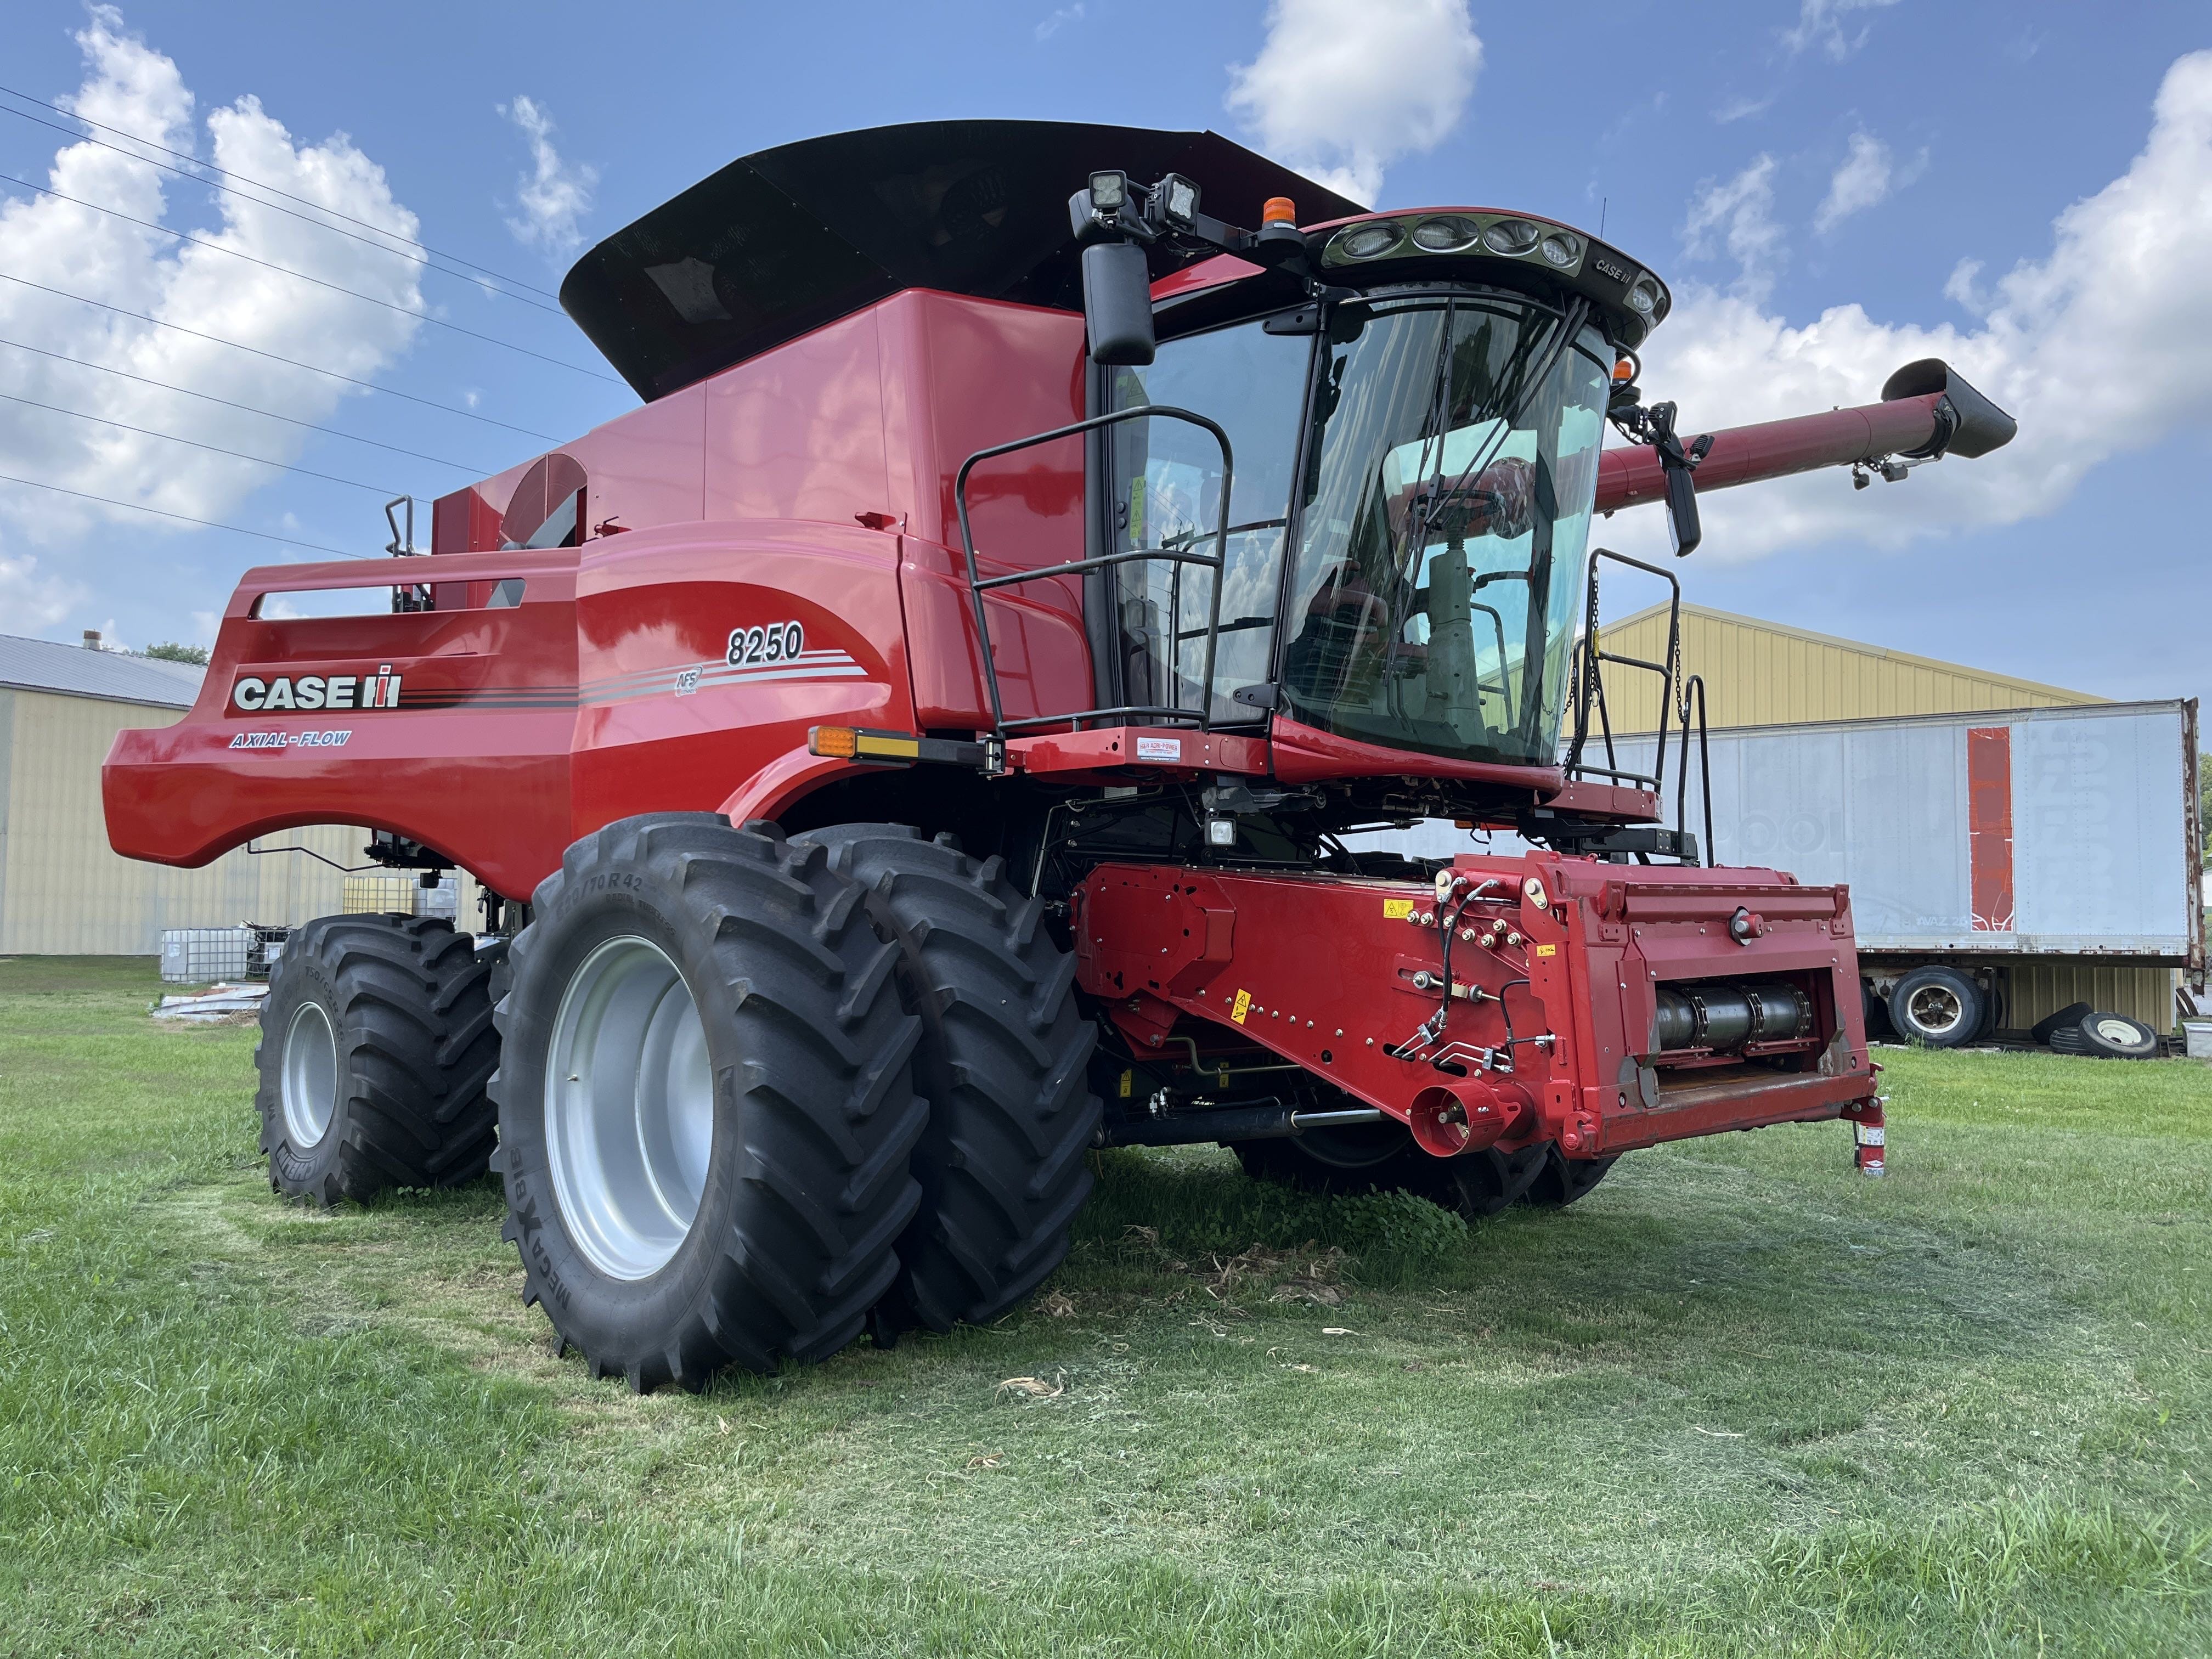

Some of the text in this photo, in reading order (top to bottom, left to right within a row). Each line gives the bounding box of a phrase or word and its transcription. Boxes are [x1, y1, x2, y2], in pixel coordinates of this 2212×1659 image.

[1596, 259, 1622, 279] CASE
[727, 620, 803, 668] 8250
[234, 676, 357, 710] CASE
[676, 672, 696, 688] AFS
